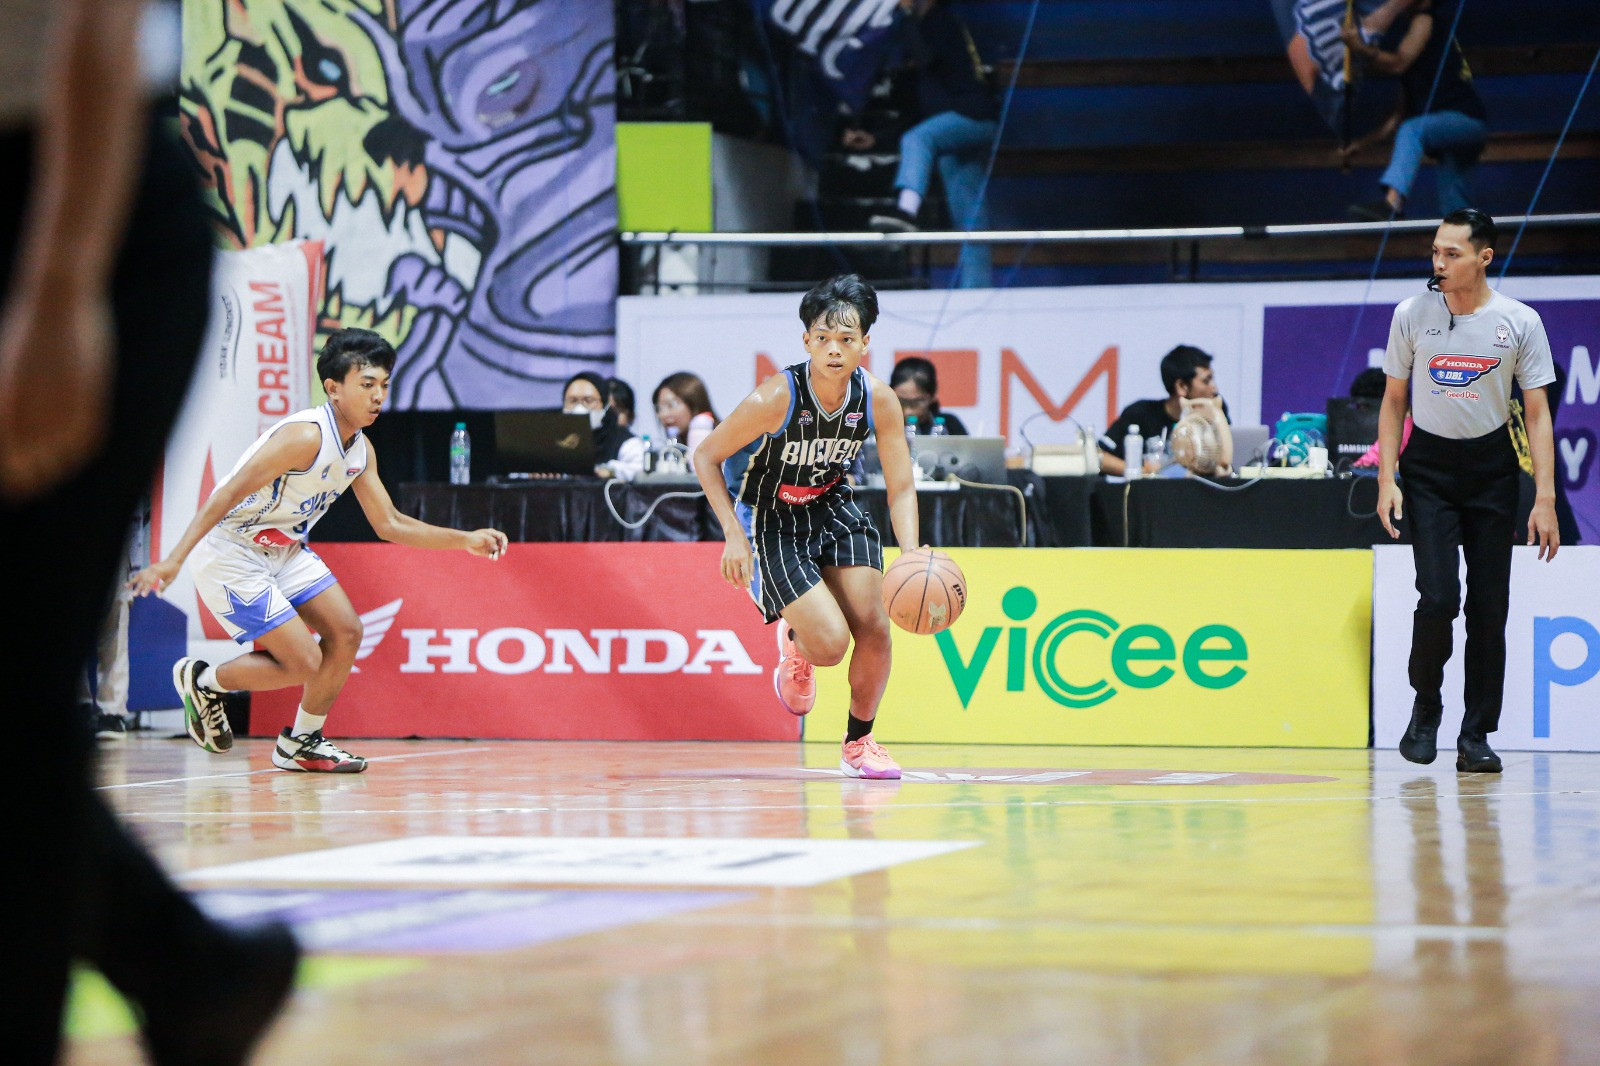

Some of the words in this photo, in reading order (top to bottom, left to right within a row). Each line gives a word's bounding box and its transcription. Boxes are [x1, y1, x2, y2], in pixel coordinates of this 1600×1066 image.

[249, 280, 290, 417] CREAM
[1446, 361, 1484, 369] HONDA
[1444, 371, 1464, 381] DBL
[1446, 390, 1465, 398] Good
[1465, 391, 1479, 400] Day
[400, 626, 763, 675] HONDA
